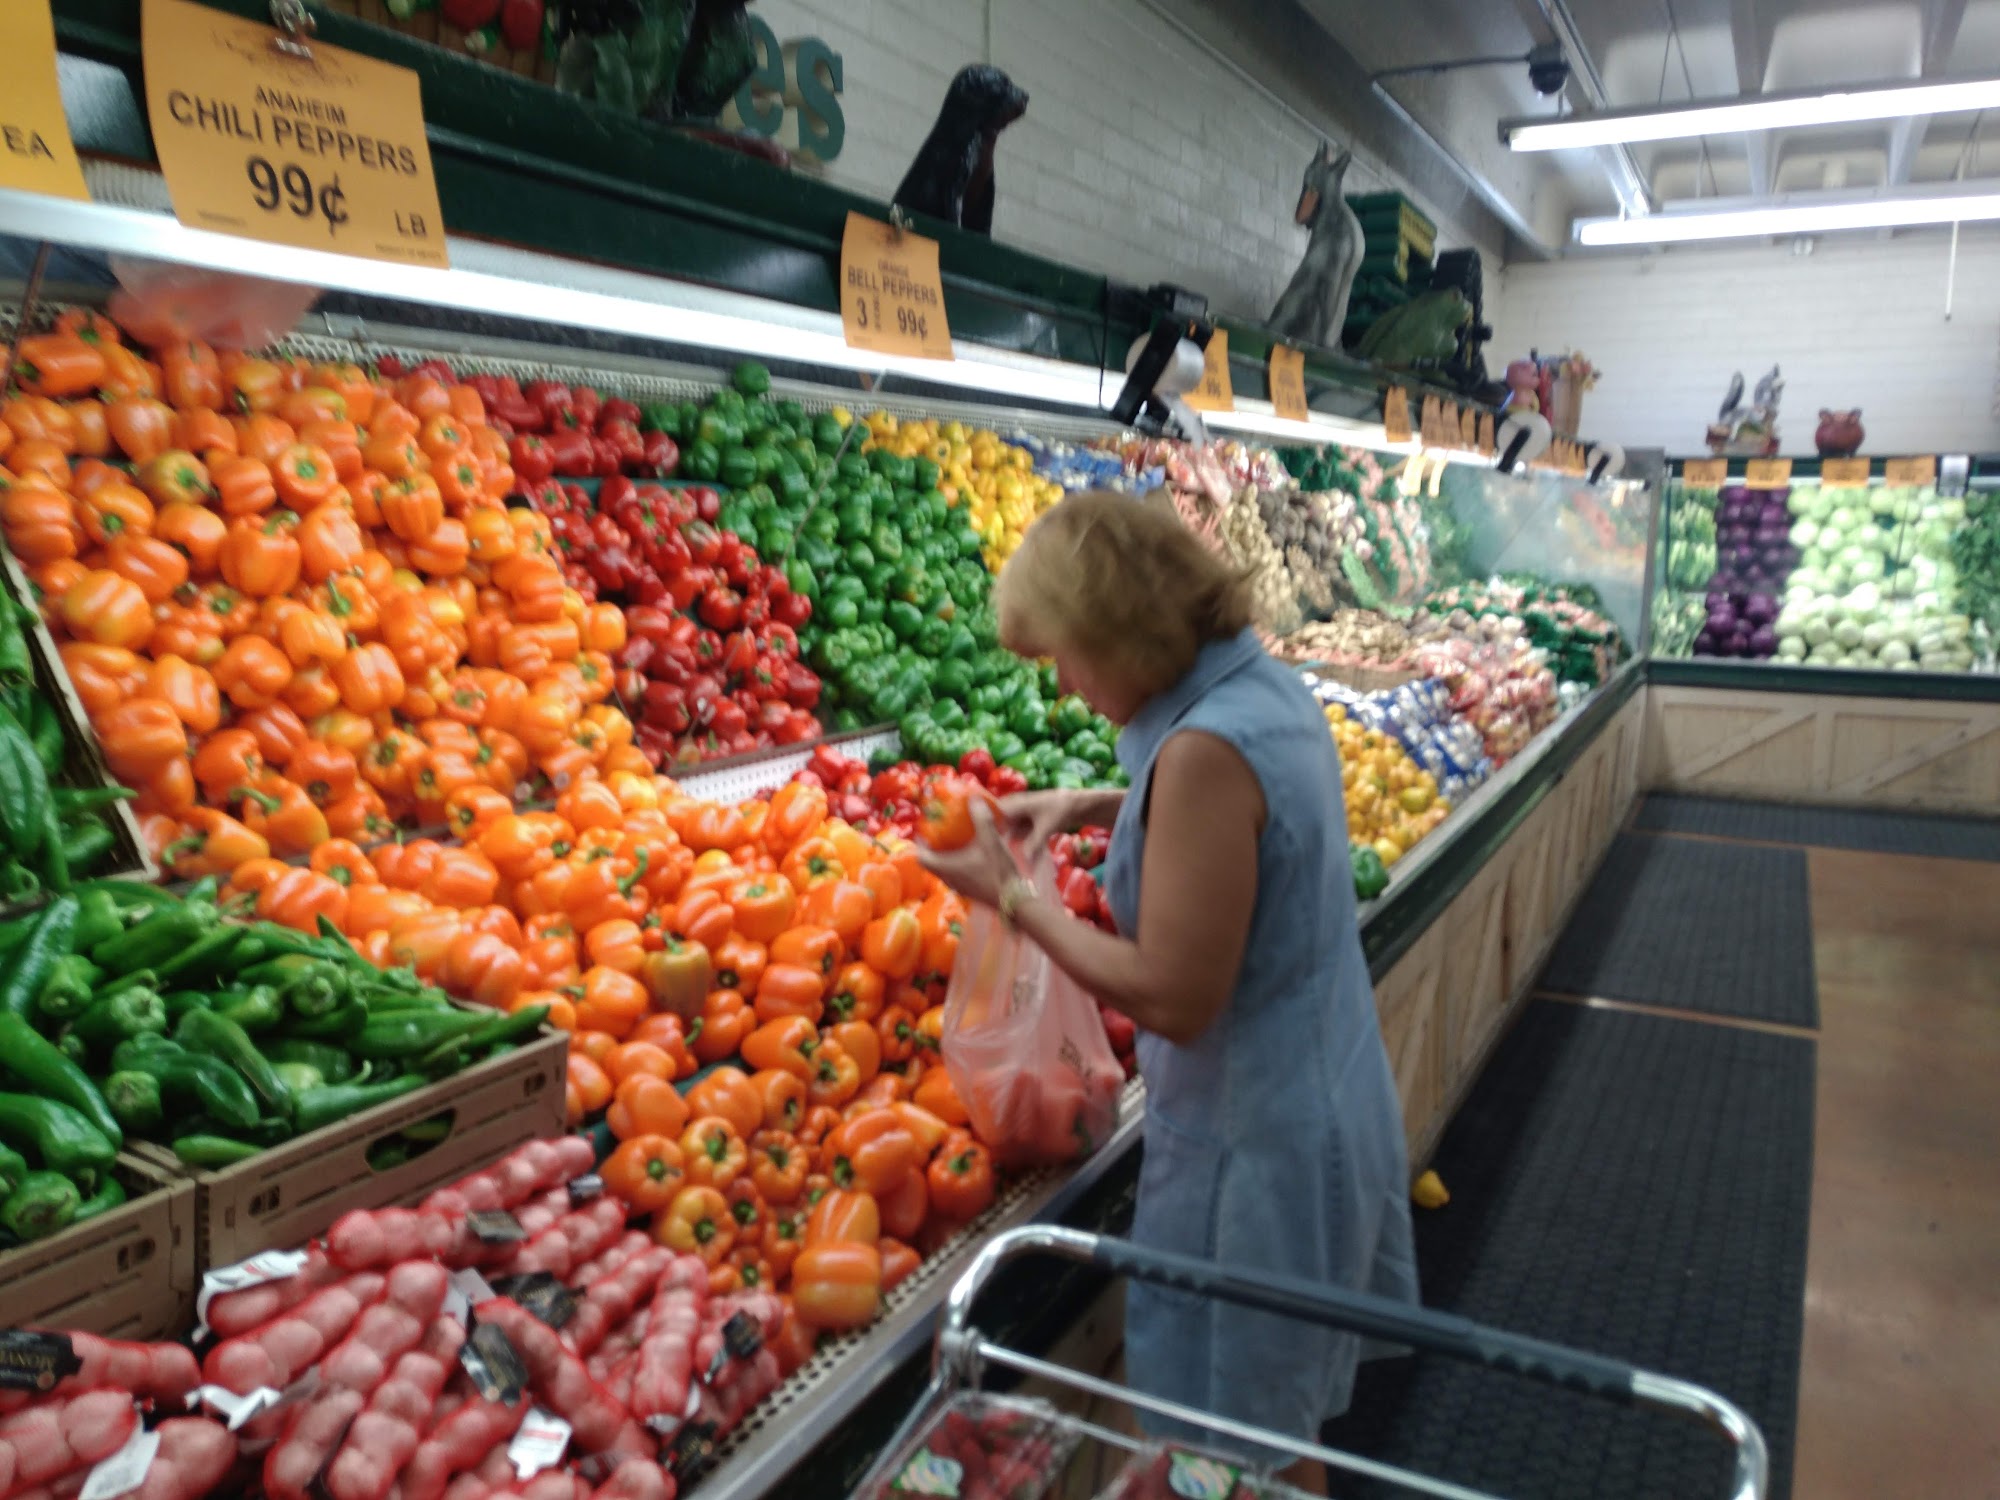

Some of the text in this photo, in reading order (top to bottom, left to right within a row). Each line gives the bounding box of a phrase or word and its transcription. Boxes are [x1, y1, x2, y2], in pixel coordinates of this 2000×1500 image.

[256, 85, 346, 125] ANAHEIM
[2, 126, 56, 162] EA
[168, 90, 417, 175] CHILI PEPPERS
[246, 156, 348, 238] 99¢
[393, 209, 428, 238] LB
[848, 265, 937, 307] BELL PEPPERS
[857, 297, 868, 330] 3
[898, 304, 928, 341] 99¢
